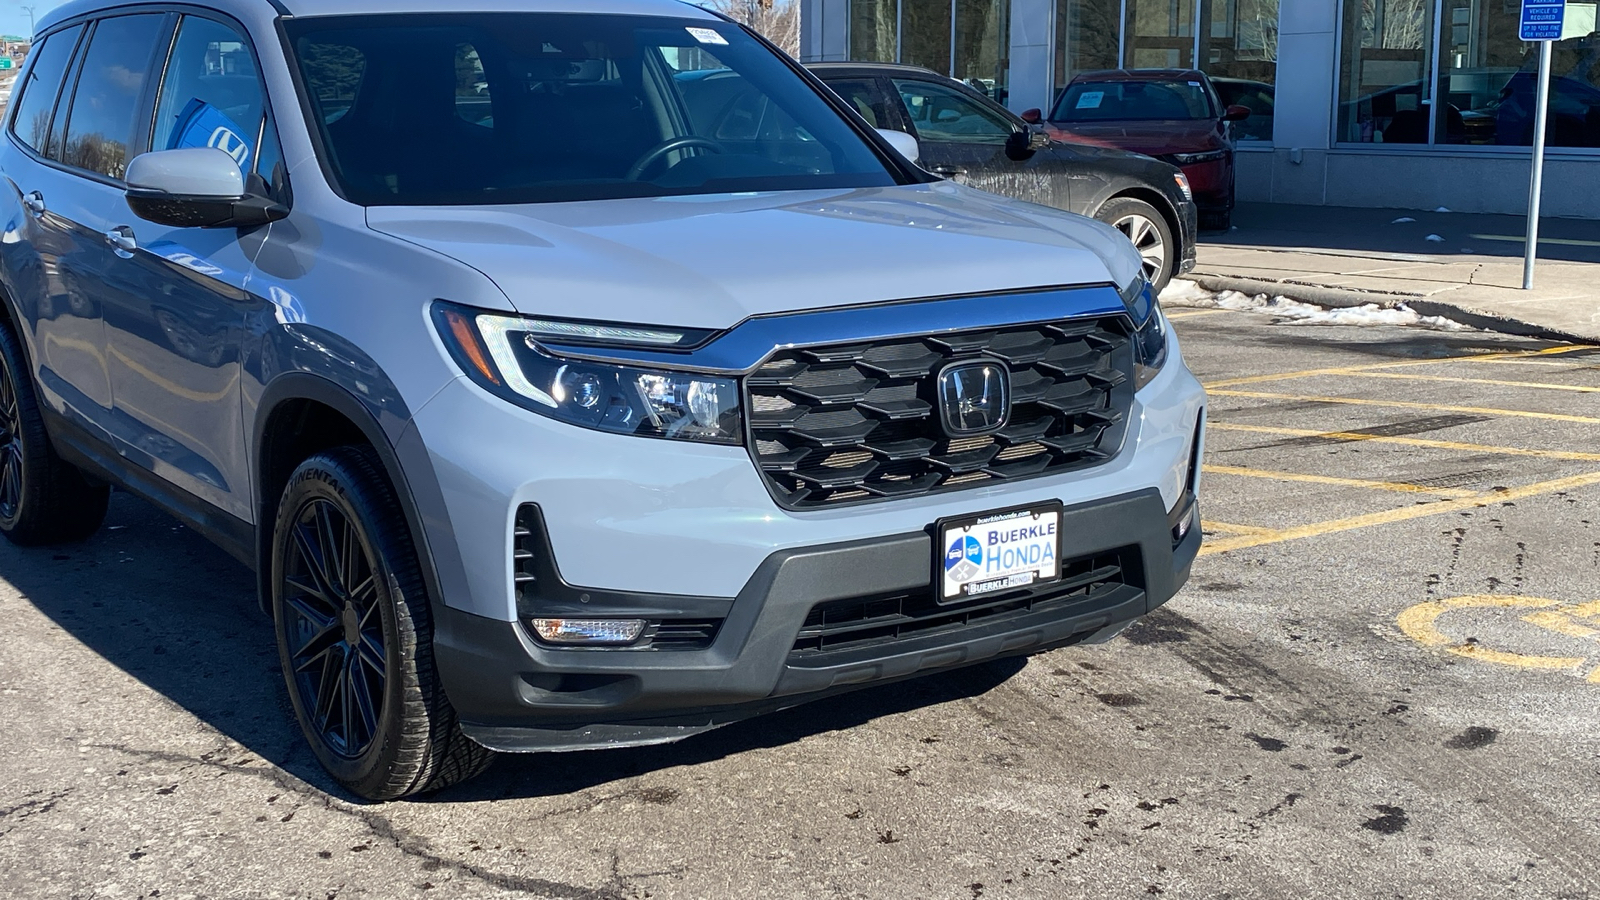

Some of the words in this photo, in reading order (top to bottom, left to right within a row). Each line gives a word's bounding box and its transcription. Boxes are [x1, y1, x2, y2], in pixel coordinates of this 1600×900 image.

[977, 511, 1031, 524] buerklehonda.com
[988, 523, 1055, 546] BUERKLE
[986, 541, 1054, 572] HONDA
[970, 578, 1008, 594] BUERKLE
[1009, 575, 1032, 585] HONDA
